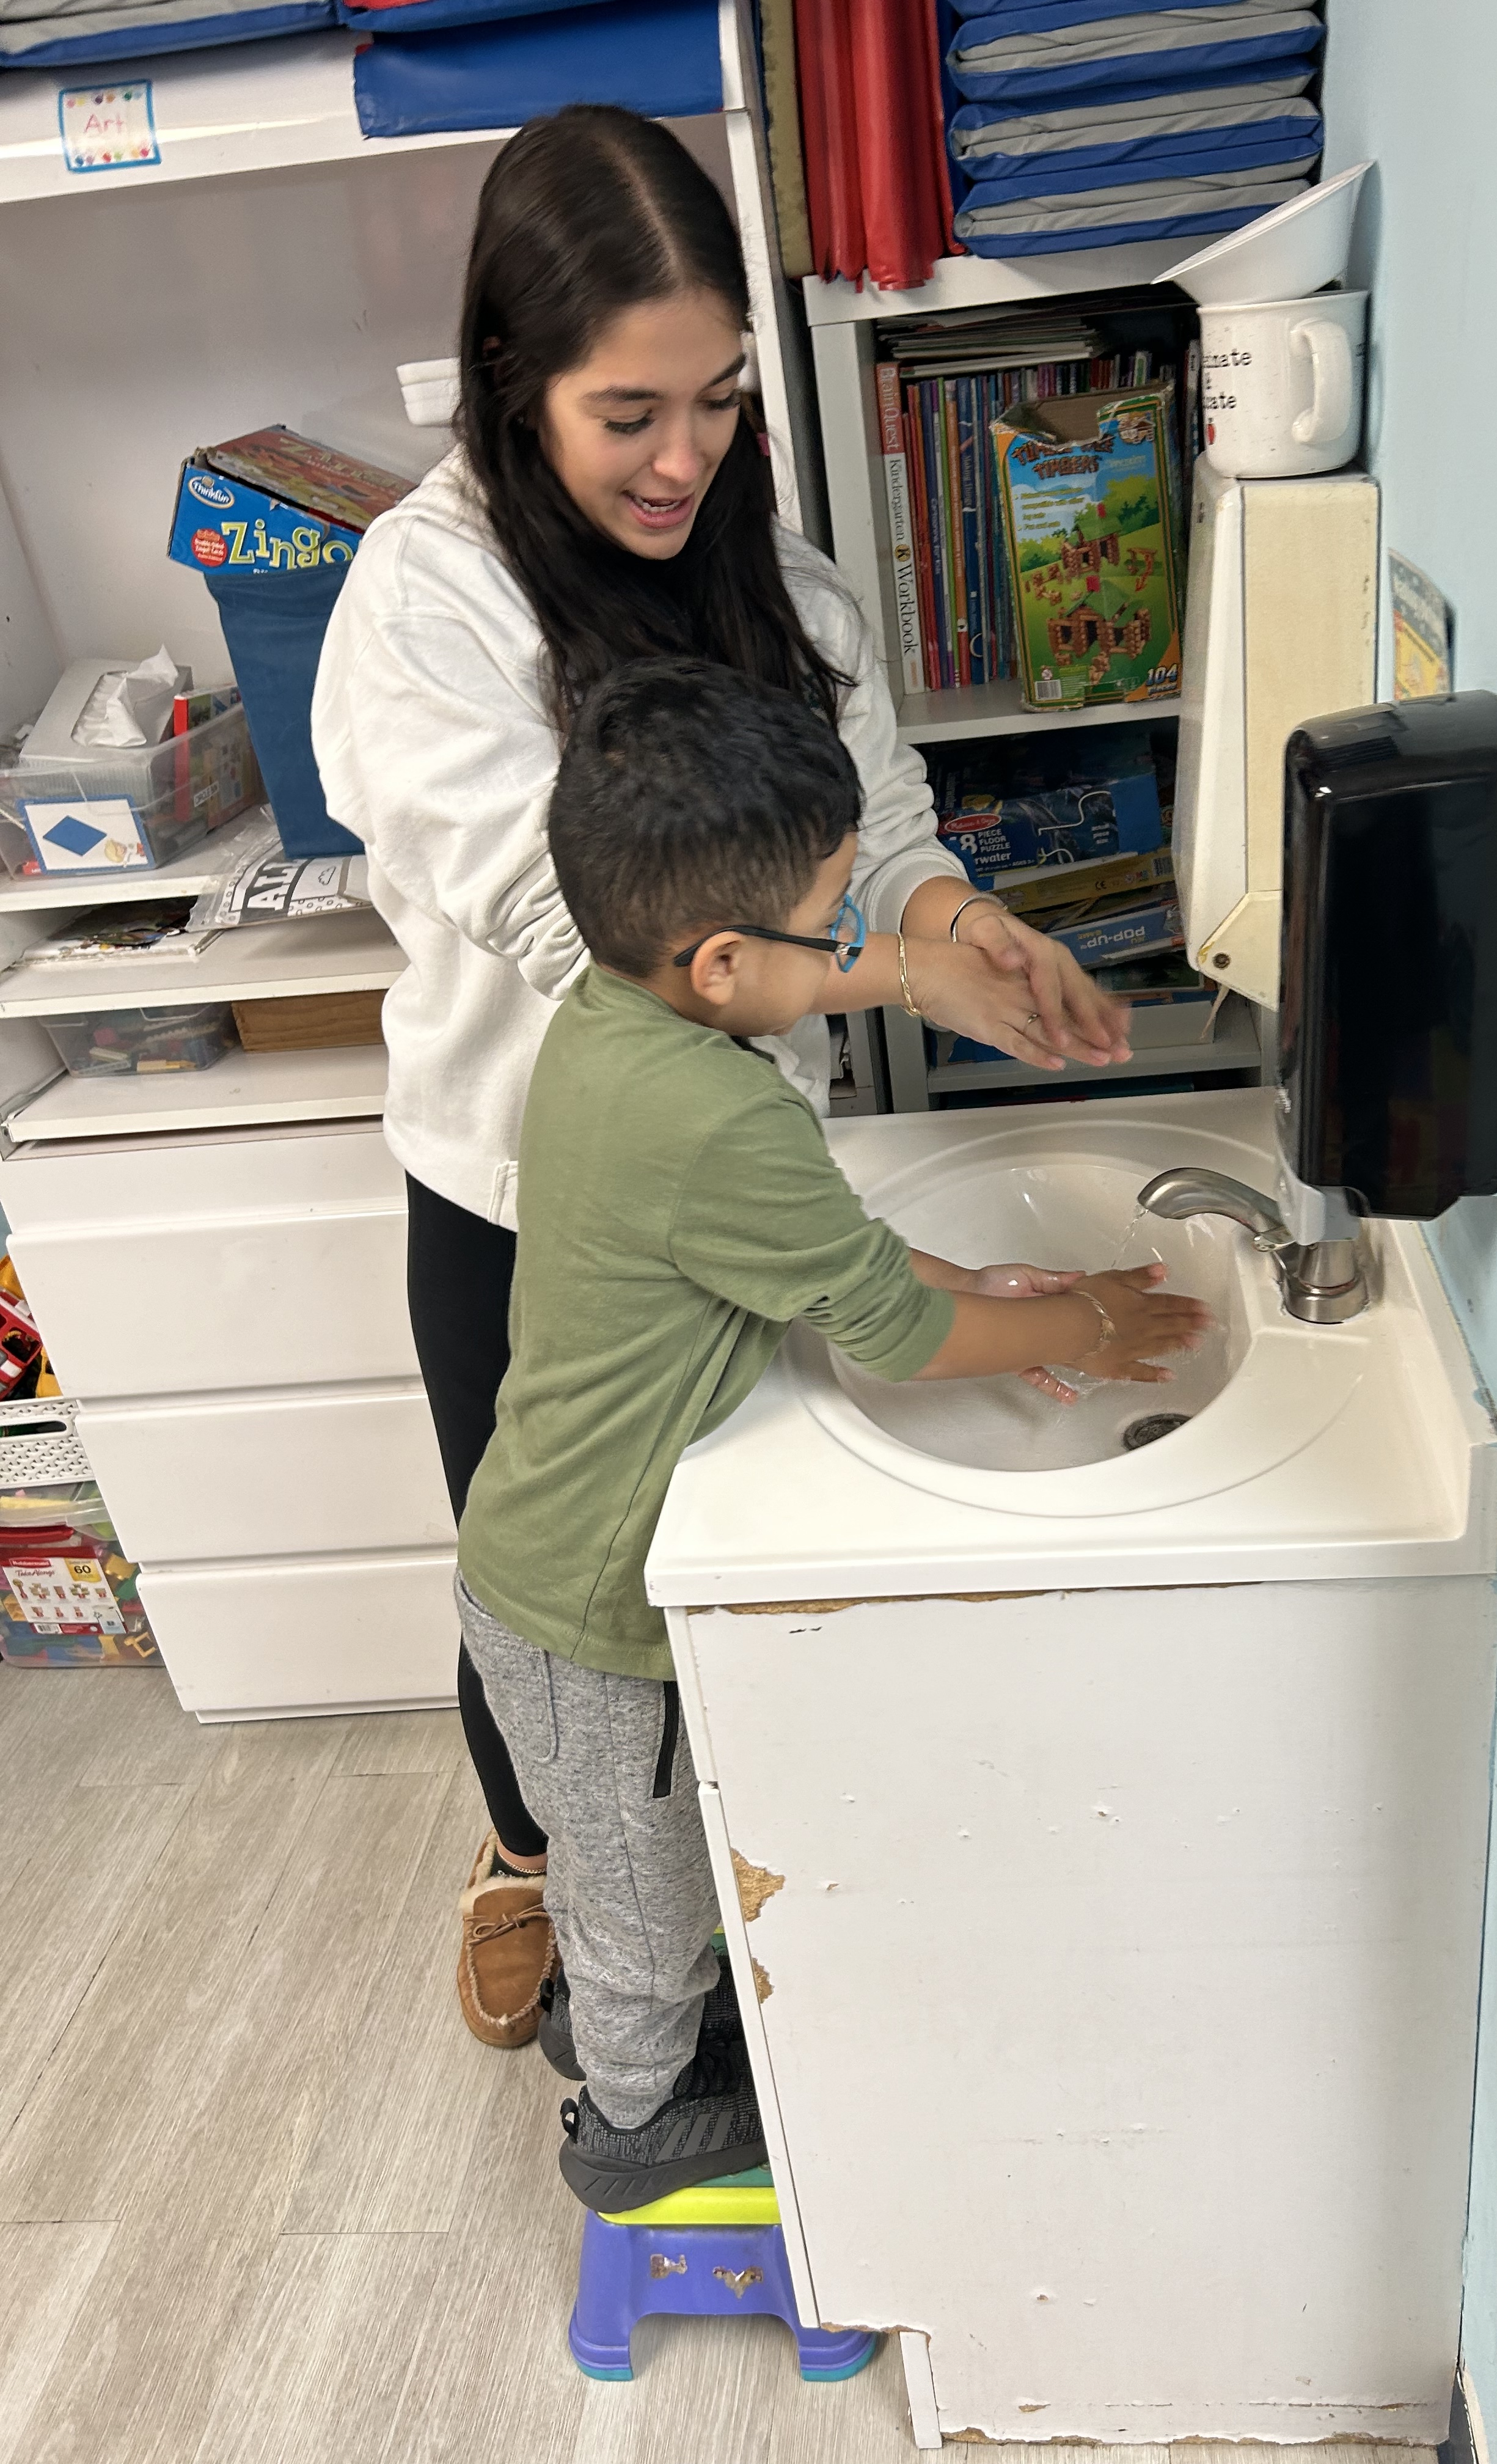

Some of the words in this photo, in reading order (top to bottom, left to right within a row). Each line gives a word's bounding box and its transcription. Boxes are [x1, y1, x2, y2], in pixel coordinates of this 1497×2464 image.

[84, 112, 124, 134] Art
[890, 458, 904, 540] Kindergarten
[897, 563, 918, 656] Workbook
[1145, 664, 1179, 686] 104
[978, 829, 1002, 838] PIECE
[978, 835, 1007, 846] FLOOR
[980, 842, 1011, 853] PUZZLE
[74, 1565, 91, 1574] 60
